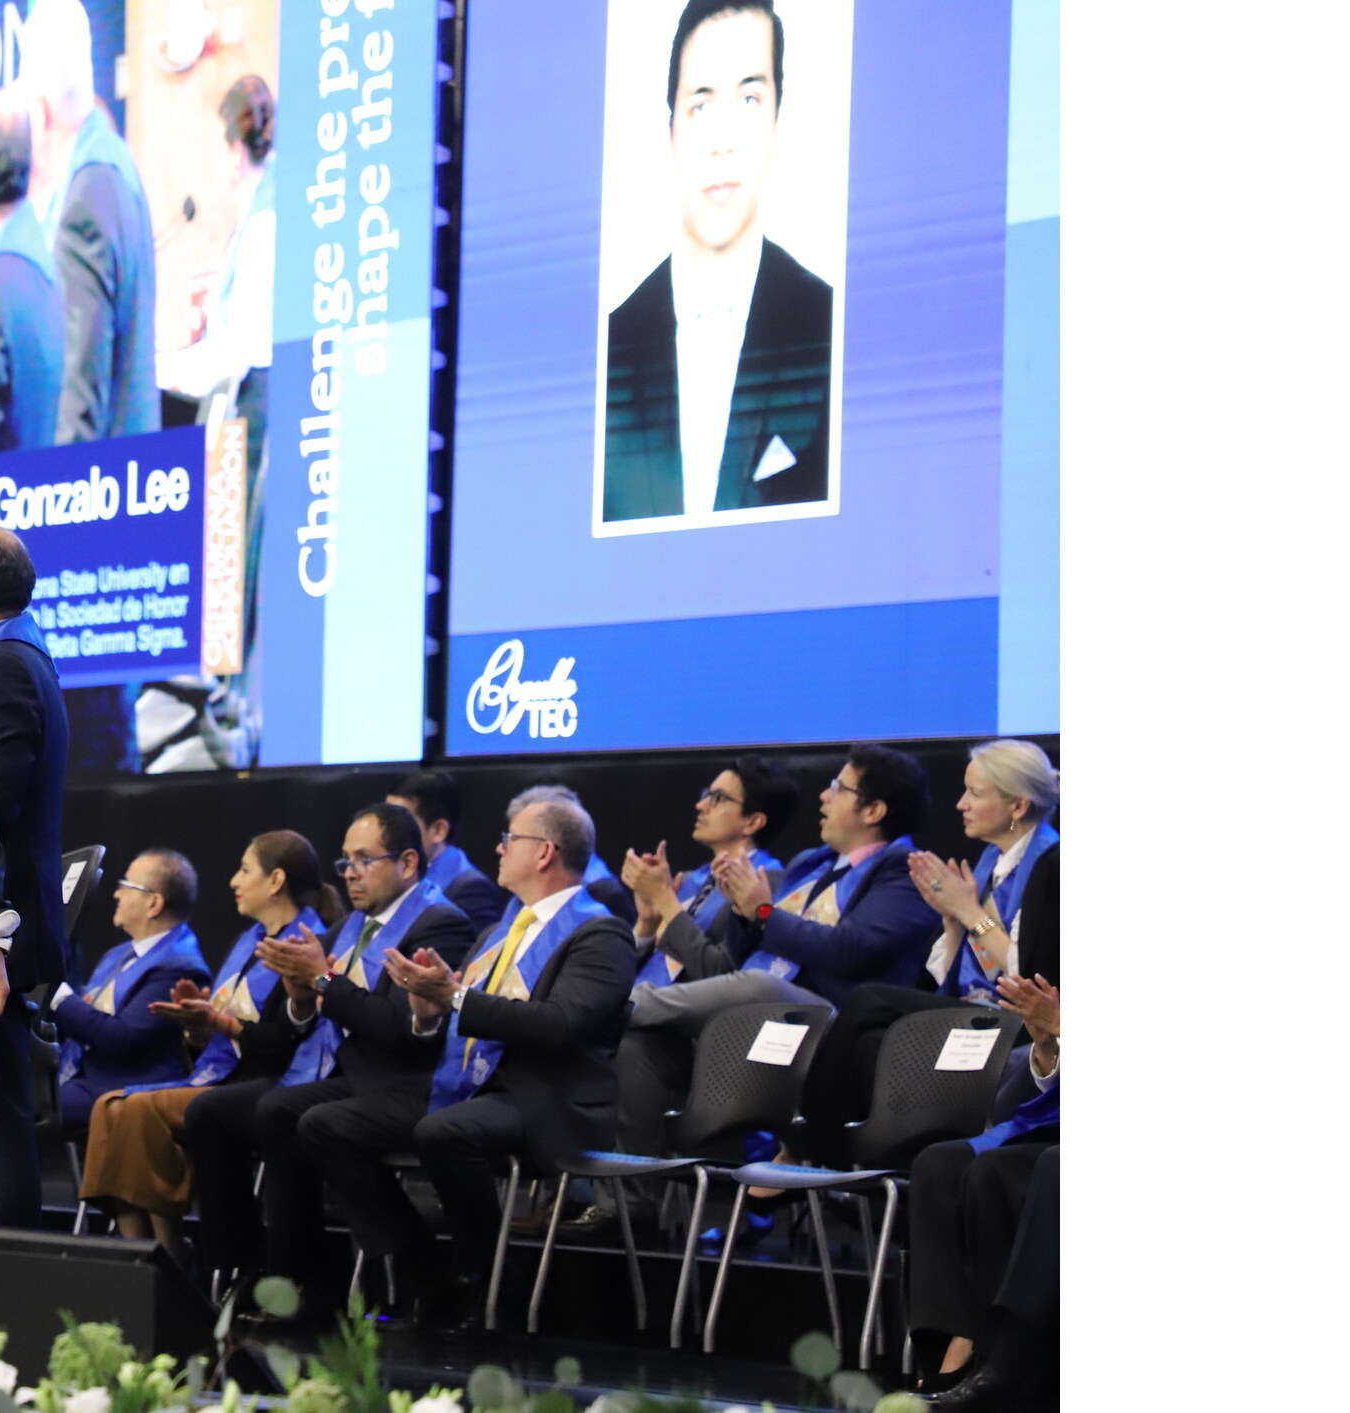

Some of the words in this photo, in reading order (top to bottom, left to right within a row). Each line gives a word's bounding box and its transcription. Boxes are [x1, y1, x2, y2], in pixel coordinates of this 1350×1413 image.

[350, 29, 394, 150] the
[305, 111, 348, 229] the
[296, 243, 353, 598] Challenge
[126, 459, 191, 516] Lee
[528, 698, 578, 738] TEC
